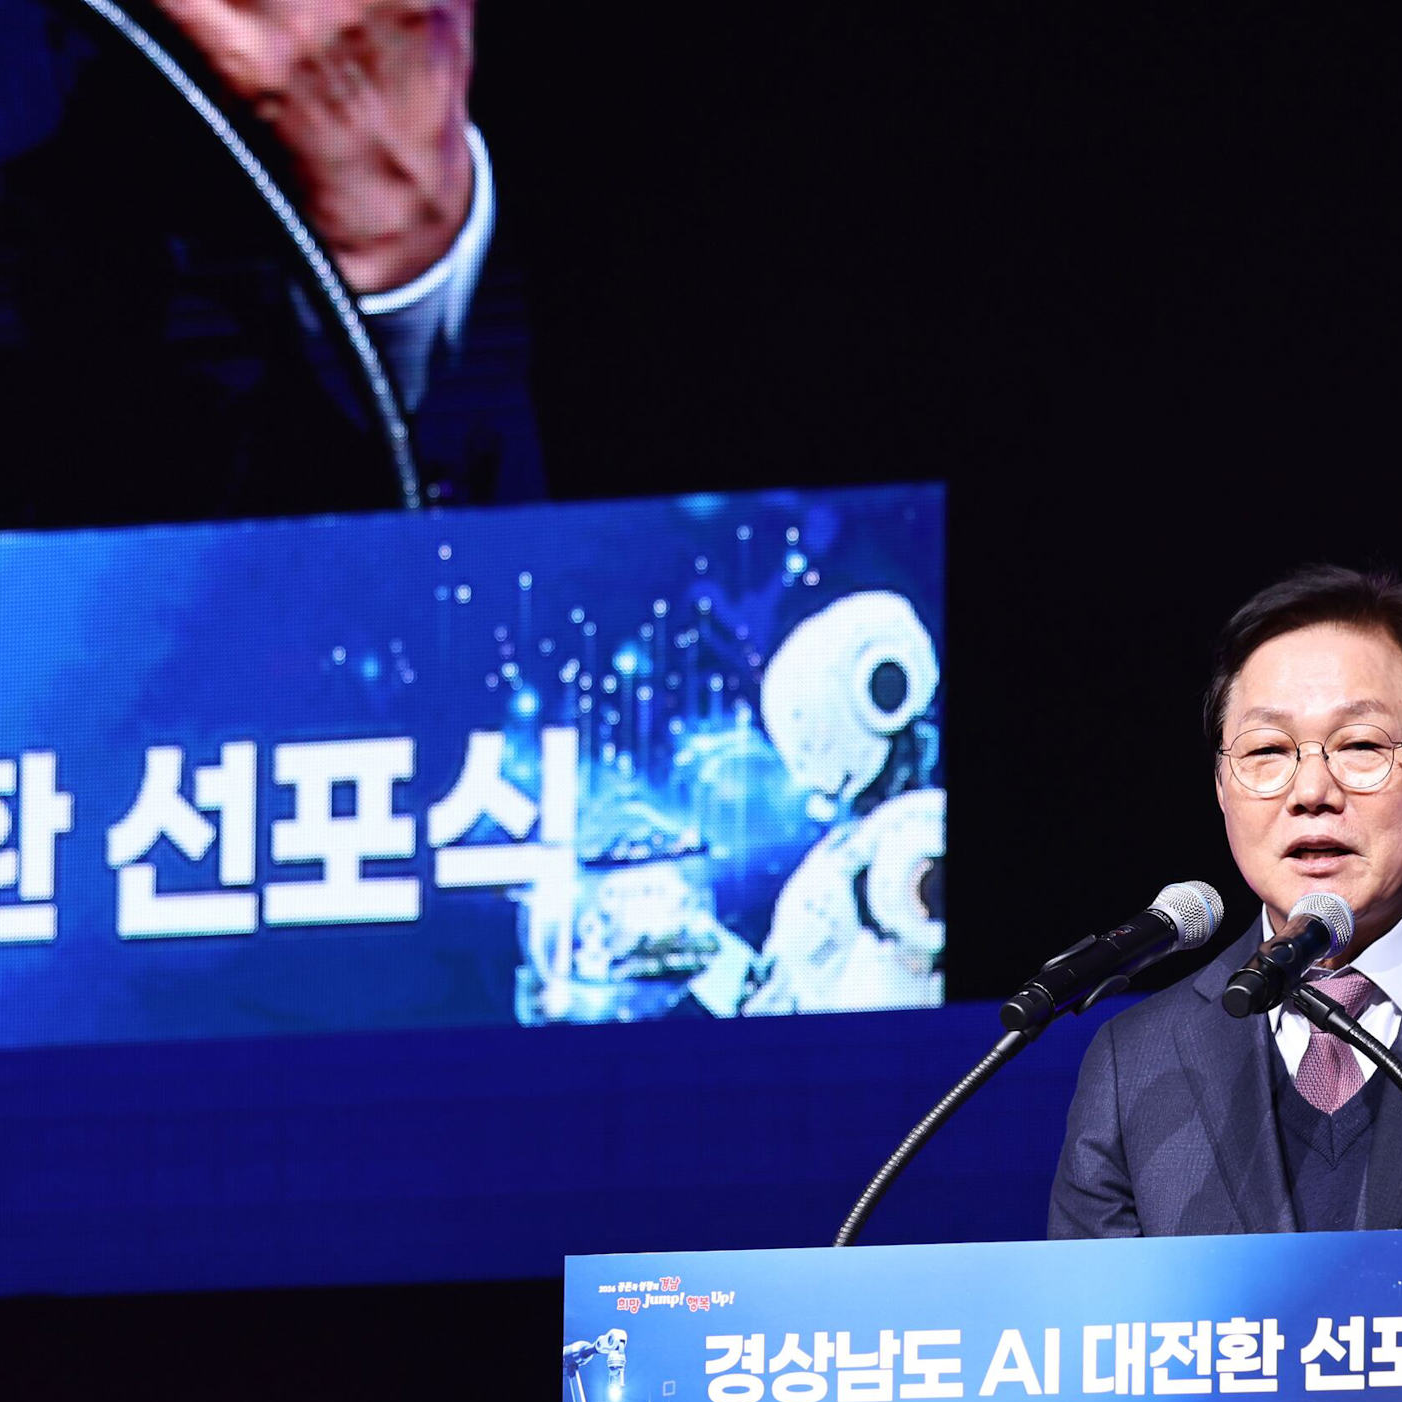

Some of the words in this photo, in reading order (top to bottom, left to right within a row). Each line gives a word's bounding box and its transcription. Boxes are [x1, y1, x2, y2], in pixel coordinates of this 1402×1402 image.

[106, 726, 579, 939] 선포식
[642, 1292, 685, 1309] Jump!
[710, 1290, 735, 1307] Up!
[978, 1328, 1060, 1397] AI
[1081, 1317, 1285, 1396] 대전환
